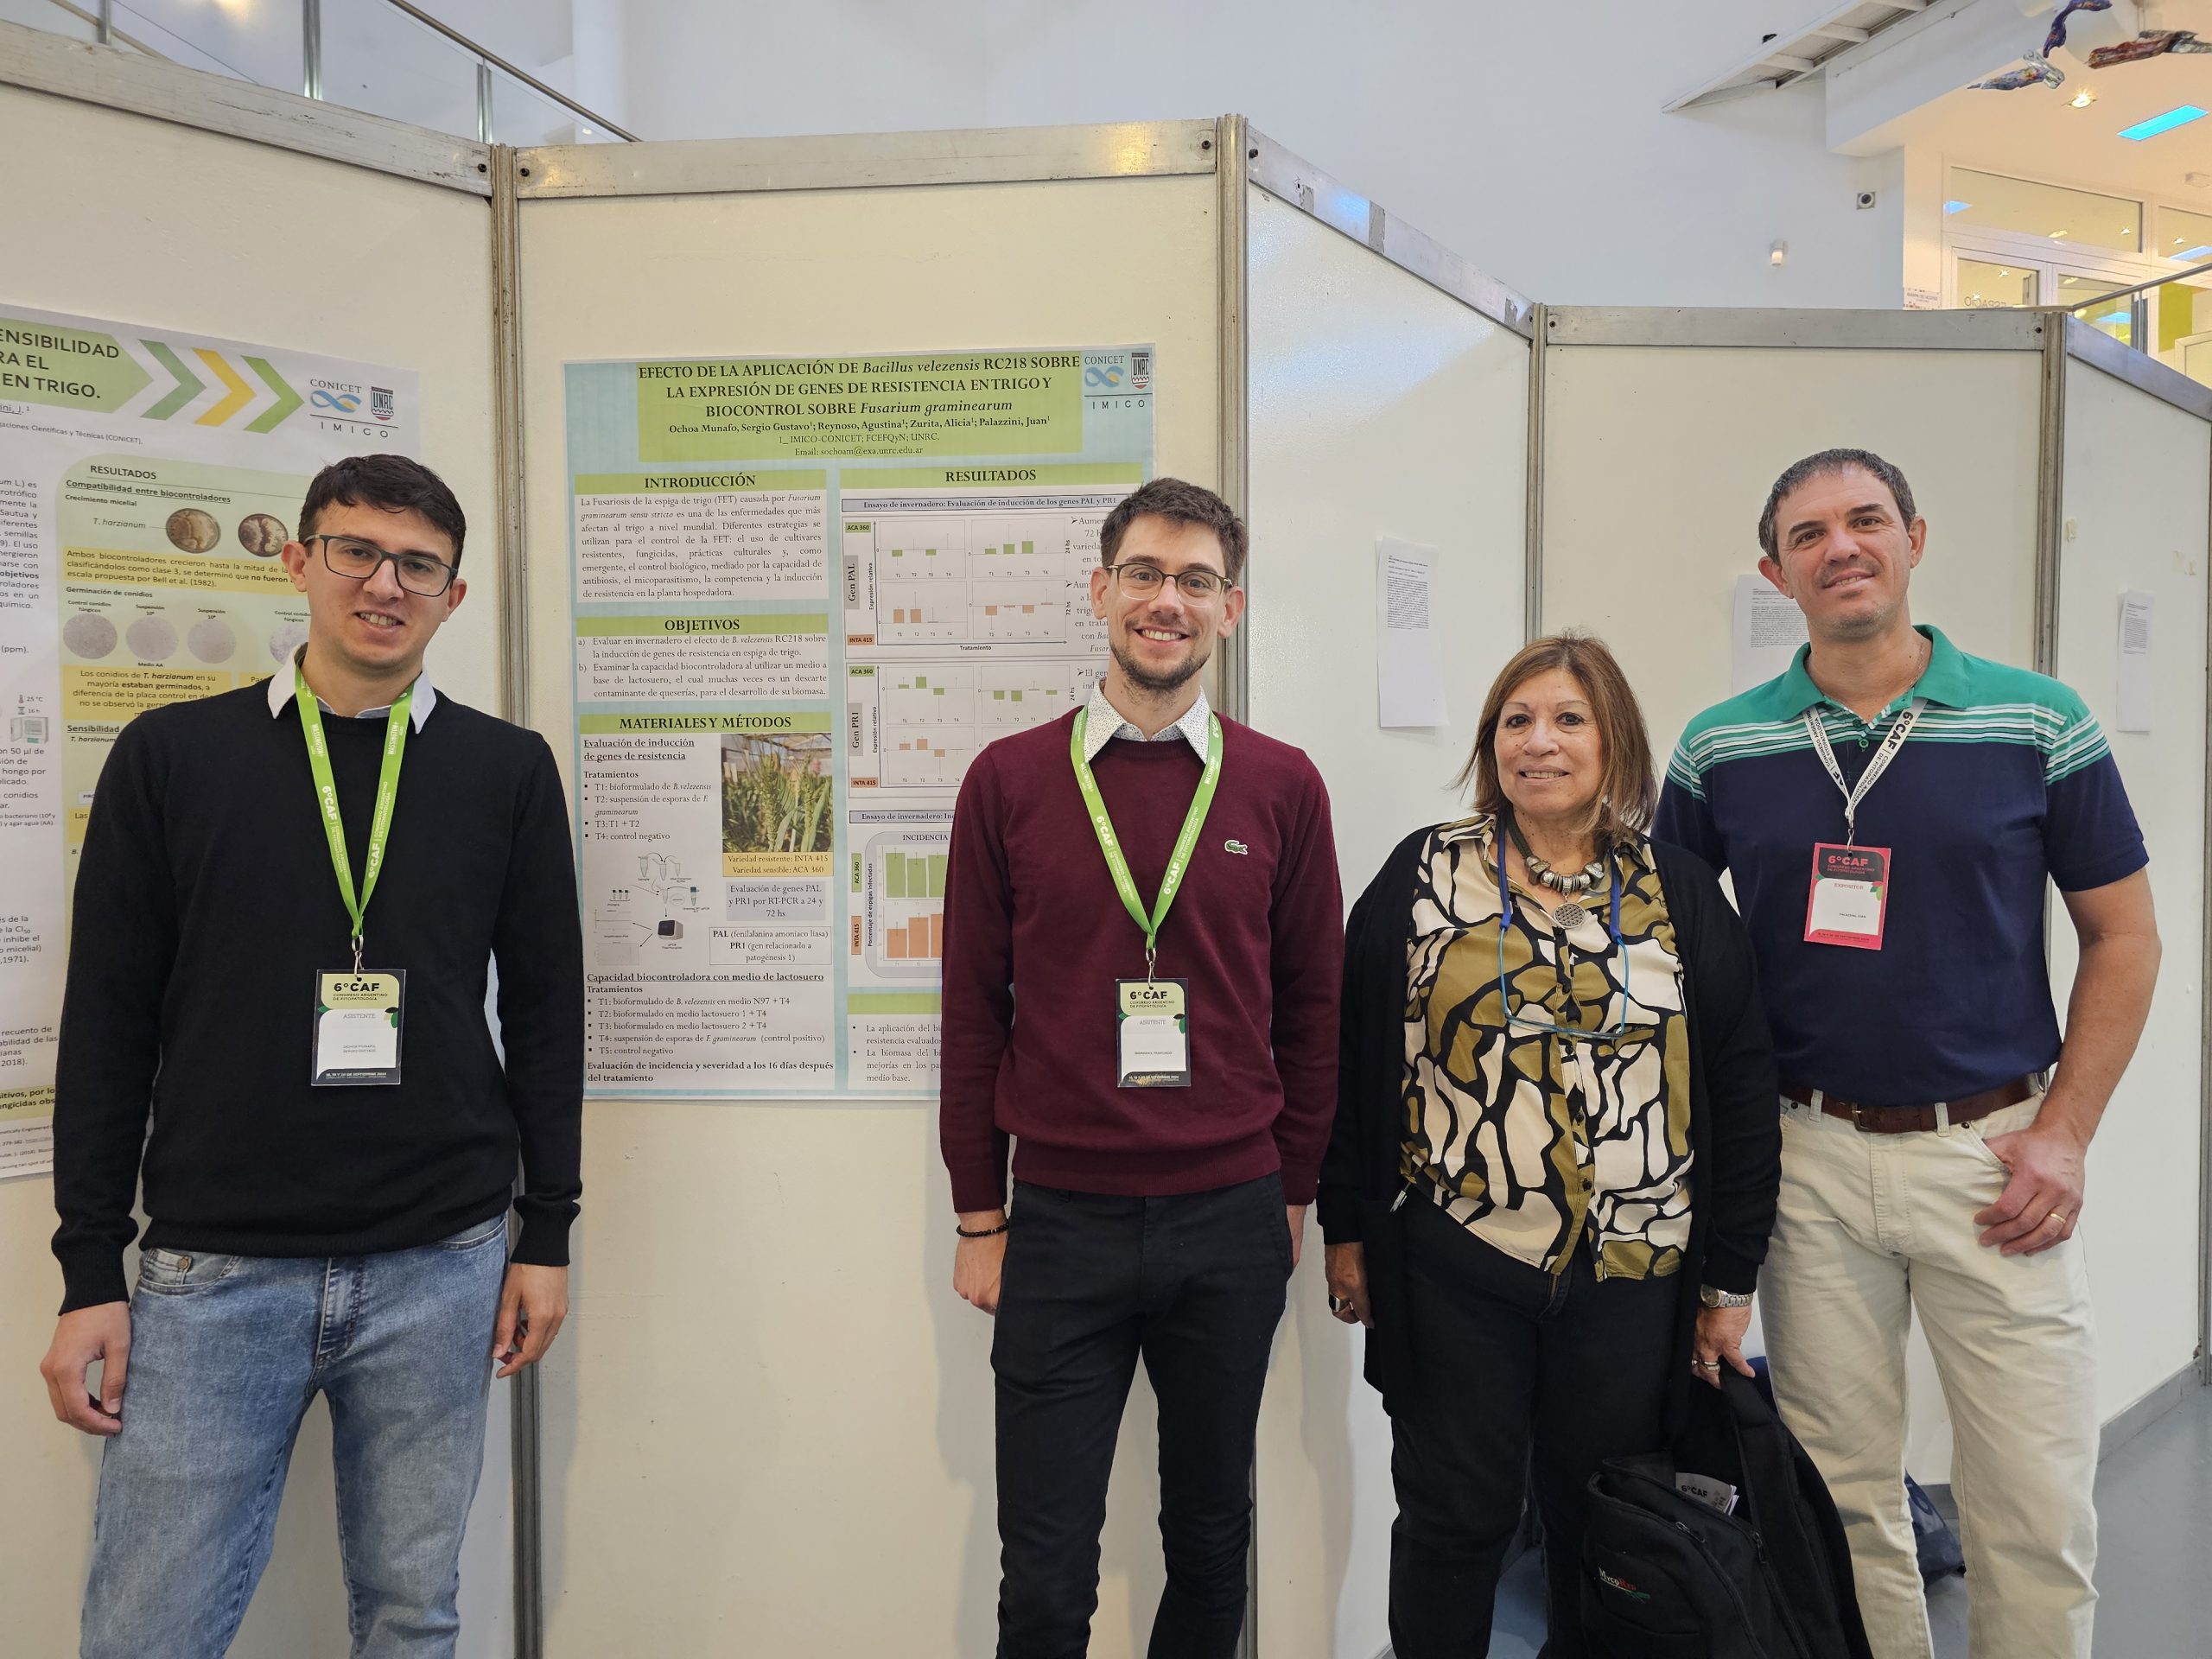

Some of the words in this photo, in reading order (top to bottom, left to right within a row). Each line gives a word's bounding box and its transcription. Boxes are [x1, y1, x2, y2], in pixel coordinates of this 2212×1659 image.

[27, 355, 48, 370] EL
[639, 365, 692, 378] EFECTO
[696, 365, 716, 377] DE
[720, 365, 739, 376] LA
[742, 359, 833, 376] APLICACIÓN
[838, 362, 858, 373] DE
[862, 360, 912, 372] Bacillus
[918, 359, 980, 371] velezensis
[983, 357, 1027, 369] RC218
[1030, 355, 1079, 368] SOBRE
[1084, 356, 1124, 365] CONICET
[1134, 358, 1149, 376] UNRC
[3, 372, 29, 388] EN
[33, 377, 100, 398] TRIGO.
[310, 378, 362, 394] CONICET
[666, 386, 684, 397] LA
[690, 381, 770, 397] EXPRESIÓN
[775, 384, 794, 395] DE
[798, 382, 843, 394] GENES
[848, 382, 868, 393] DE
[871, 379, 965, 392] RESISTENCIA
[970, 378, 991, 390] EN
[990, 377, 1039, 390] TRIGO
[1042, 377, 1051, 388] Y
[373, 392, 393, 410] UNRC
[706, 404, 804, 416] BIOCONTROL
[807, 403, 855, 414] SOBRE
[860, 401, 920, 413] Fusarium
[924, 399, 1012, 416] graminearum
[90, 467, 156, 479] RESULTADOS
[645, 472, 755, 487] INTRODUCCIÓN
[945, 469, 1036, 481] RESULTADOS
[66, 479, 131, 494] Compatibilidad
[160, 489, 231, 502] biocontroladores
[65, 493, 108, 503] Crecimiento
[102, 518, 145, 528] harzianum
[67, 550, 95, 558] Ambos
[99, 552, 167, 563] biocontroladores
[66, 586, 111, 594] Germinación
[664, 619, 740, 633] OBJETIVOS
[620, 717, 706, 728] MATERIALES
[708, 717, 717, 728] Y
[721, 714, 791, 728] MÉTODOS
[596, 753, 622, 762] genes
[624, 751, 635, 760] de
[587, 972, 633, 983] Capacidad
[636, 972, 710, 981] biocontroladora
